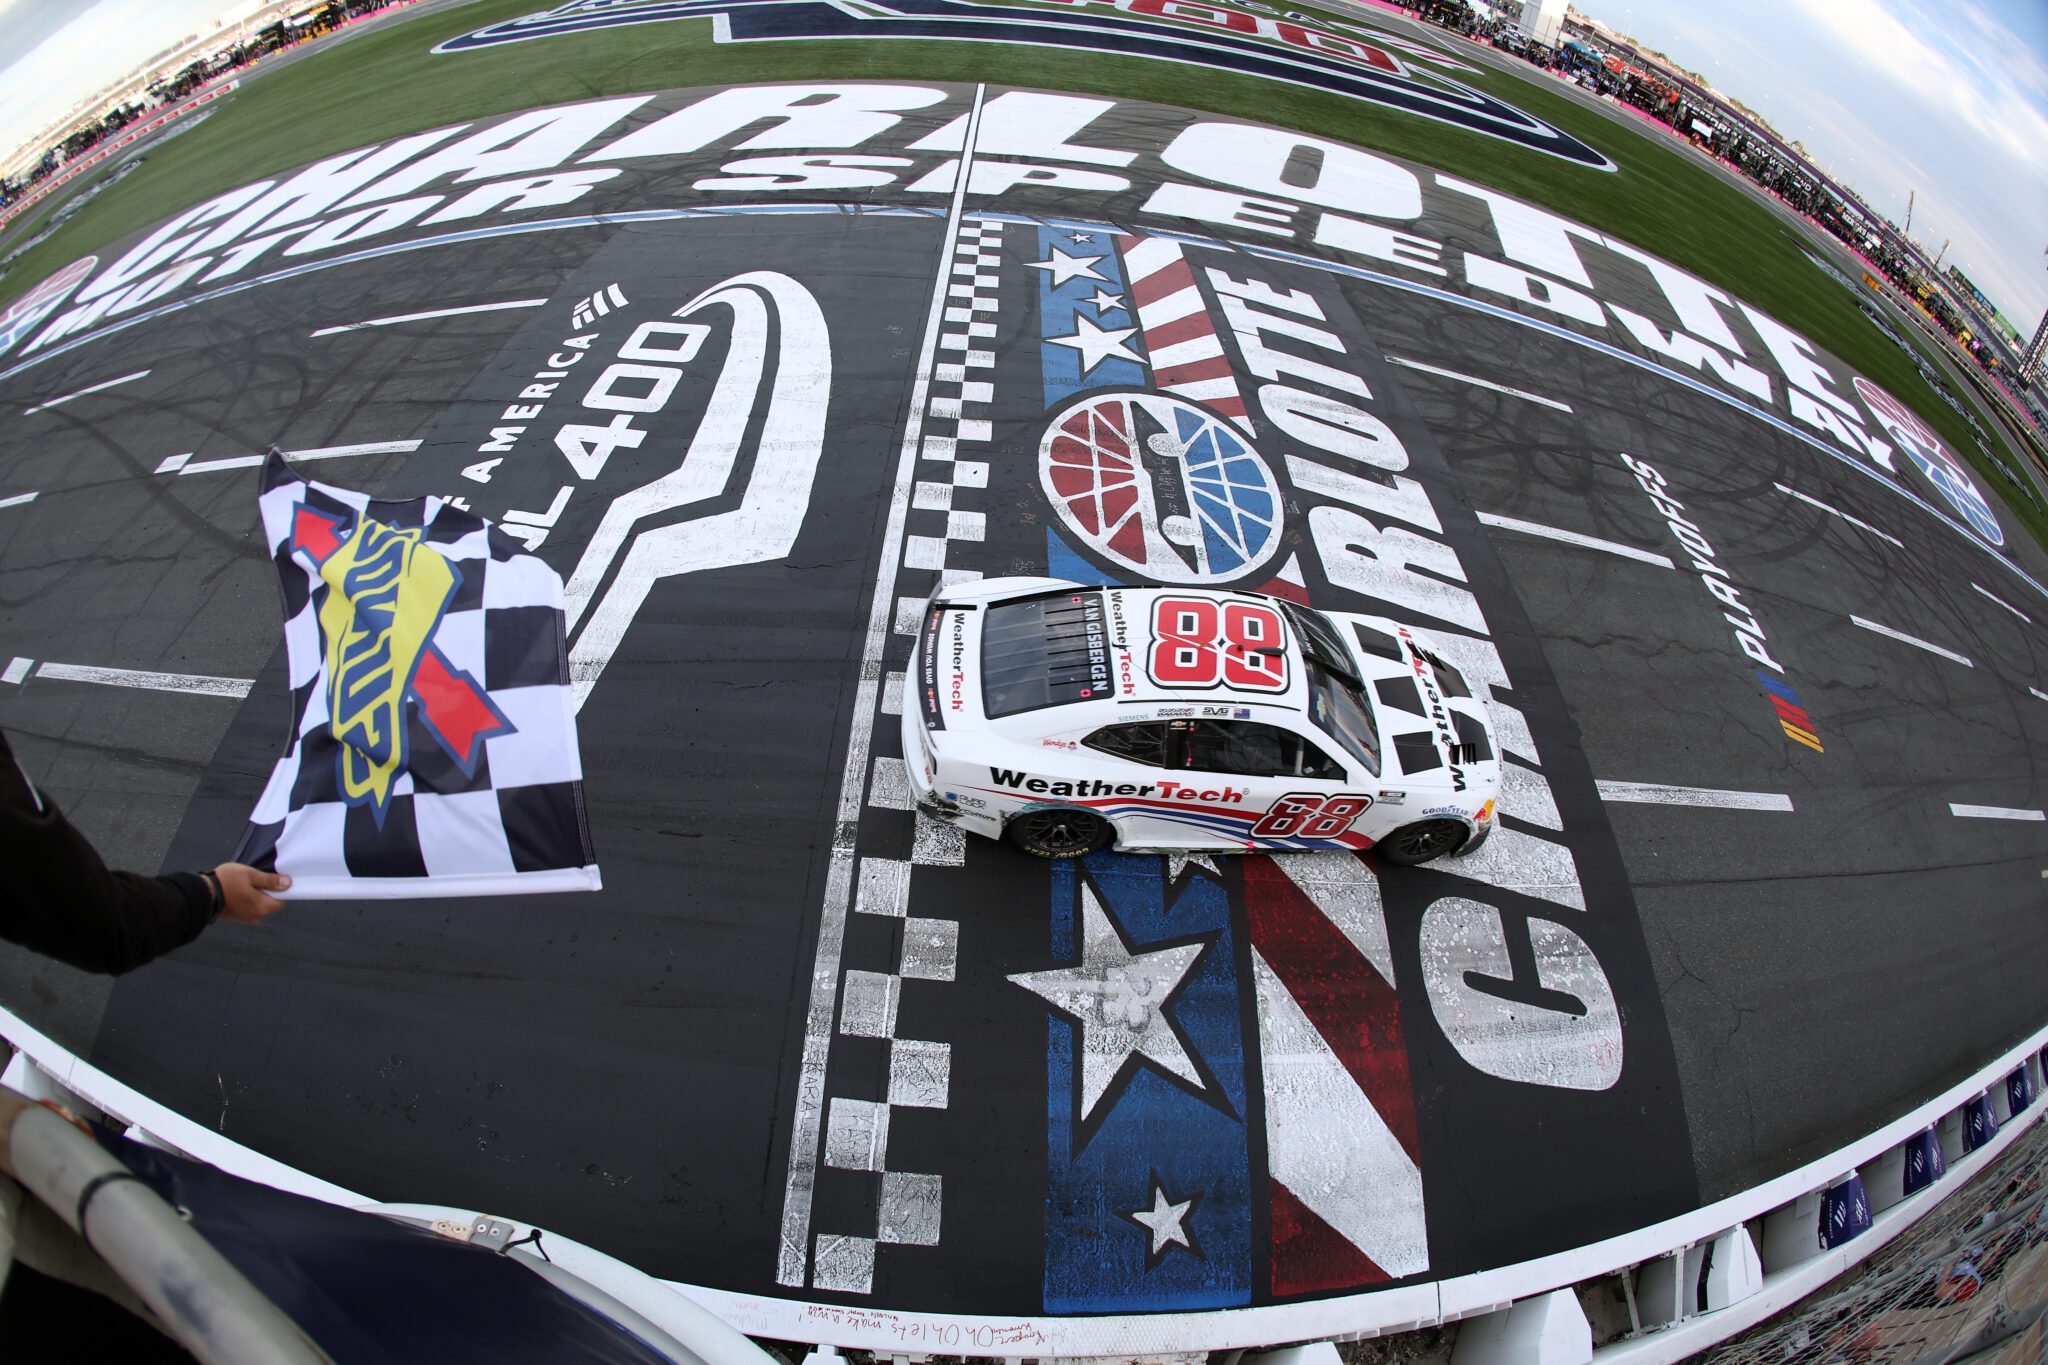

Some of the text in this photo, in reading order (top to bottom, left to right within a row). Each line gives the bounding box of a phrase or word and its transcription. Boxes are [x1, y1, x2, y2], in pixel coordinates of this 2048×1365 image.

[75, 83, 1866, 427] CHARLOTTE
[18, 155, 1897, 473] MOTOR SPEEDWAY
[460, 332, 600, 484] AMERICA
[553, 320, 712, 481] 400
[1620, 452, 1785, 675] PLAYOFFS
[951, 612, 966, 711] WeatherTech
[1083, 598, 1108, 692] VAN GISBERGEN
[1110, 591, 1136, 695] WeatherTech
[1146, 595, 1291, 694] 88
[989, 766, 1243, 804] WeatherTech
[1249, 792, 1374, 839] 88
